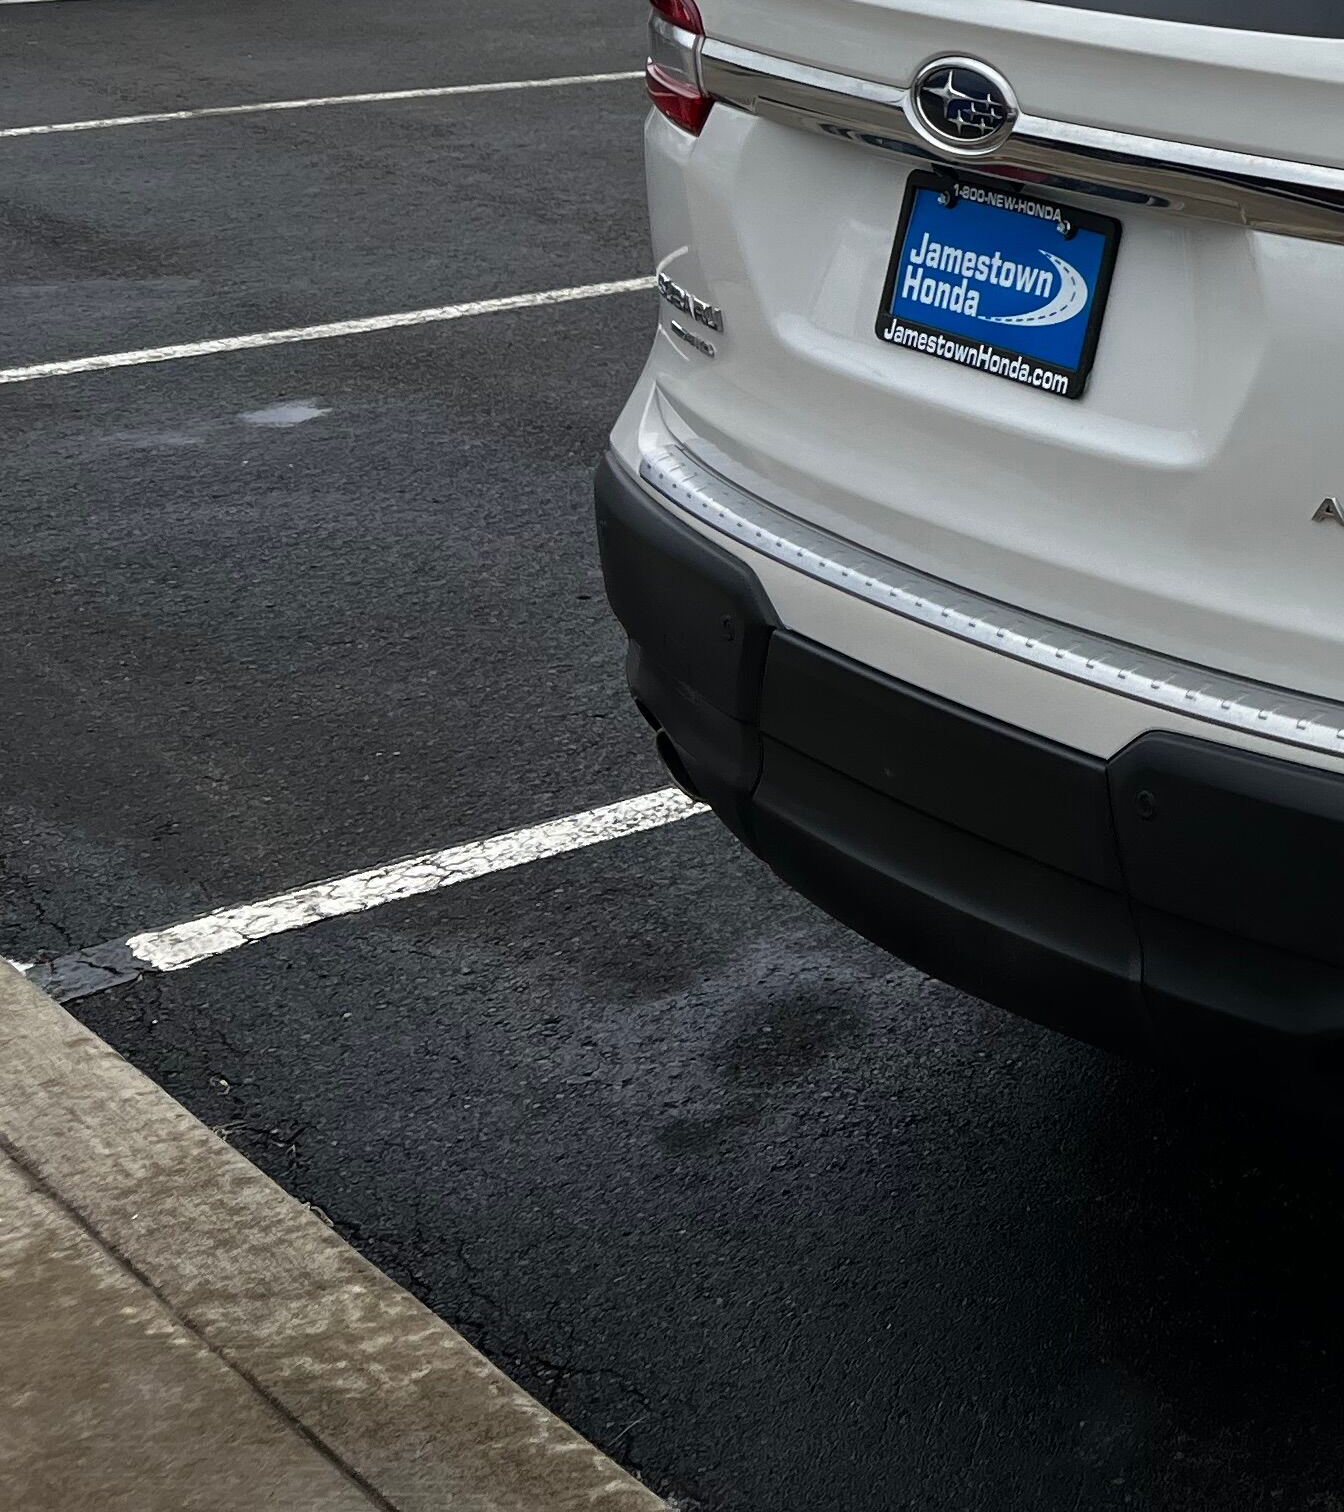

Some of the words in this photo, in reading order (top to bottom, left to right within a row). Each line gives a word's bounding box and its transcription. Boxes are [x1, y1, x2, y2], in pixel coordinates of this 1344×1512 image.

[953, 183, 1062, 223] 1-800-NEW-HONDA
[901, 264, 980, 318] Honda
[910, 232, 1054, 298] Jamestown
[884, 319, 1068, 394] JamestownHonda.com
